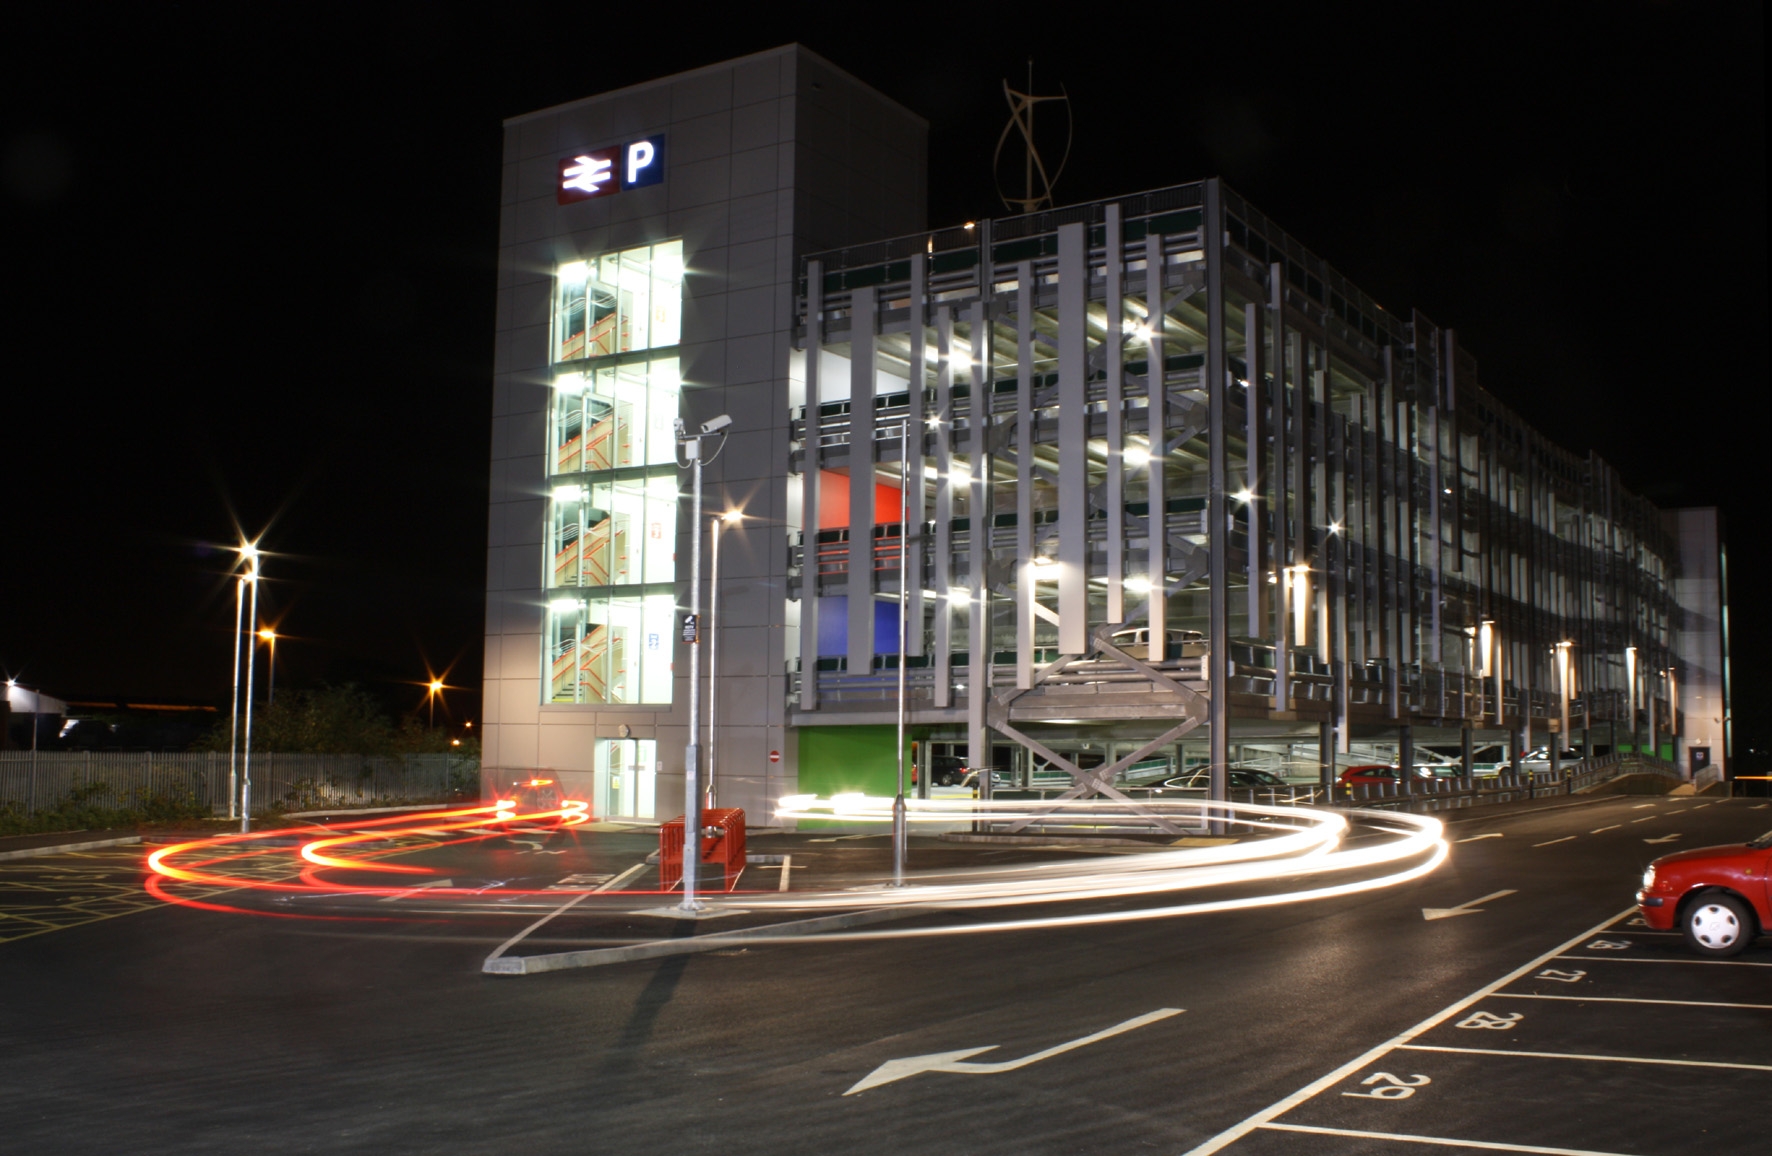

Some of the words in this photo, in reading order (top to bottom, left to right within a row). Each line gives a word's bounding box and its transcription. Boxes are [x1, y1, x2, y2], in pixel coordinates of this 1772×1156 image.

[628, 141, 654, 183] P
[1586, 940, 1633, 950] 26
[1534, 969, 1587, 983] 27
[1454, 1011, 1524, 1030] 28
[1341, 1071, 1432, 1100] 29
